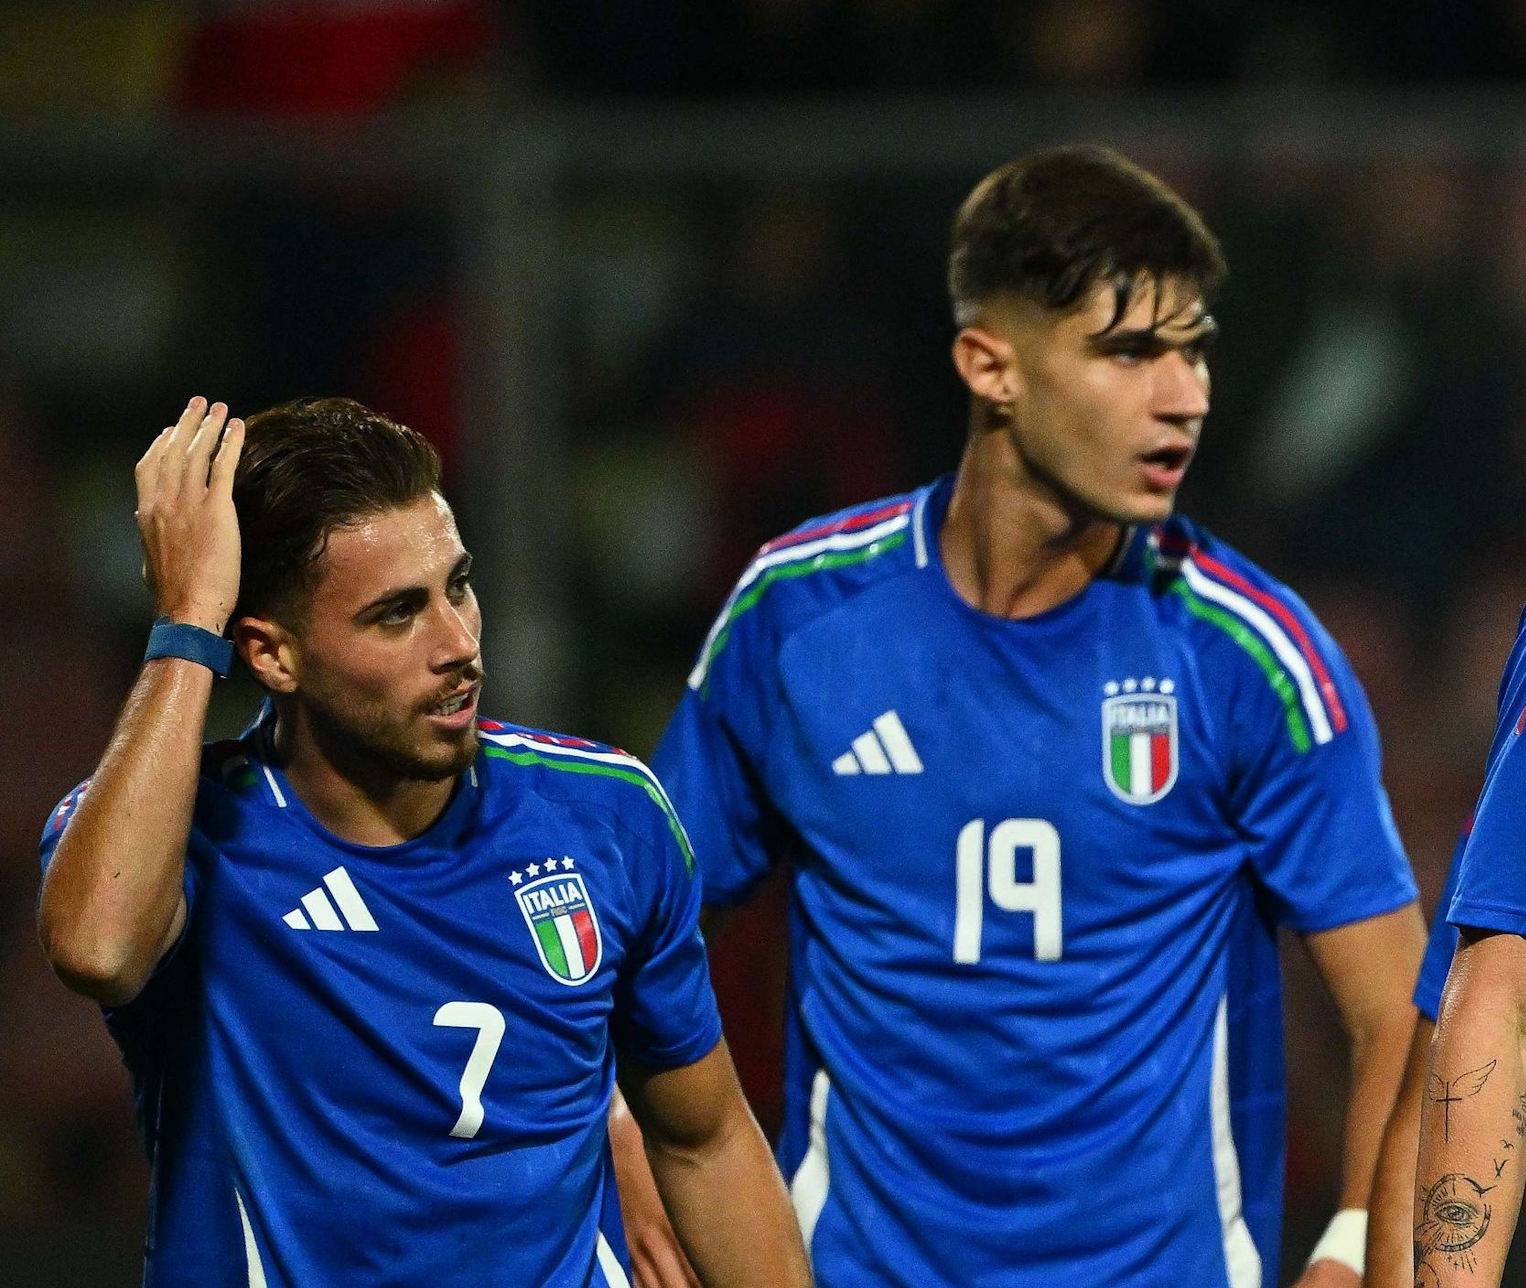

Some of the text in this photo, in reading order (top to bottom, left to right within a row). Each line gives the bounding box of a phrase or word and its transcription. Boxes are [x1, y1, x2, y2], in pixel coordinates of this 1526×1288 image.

[522, 881, 583, 914] ITALIA
[953, 818, 1063, 964] 19
[432, 1001, 506, 1138] 7
